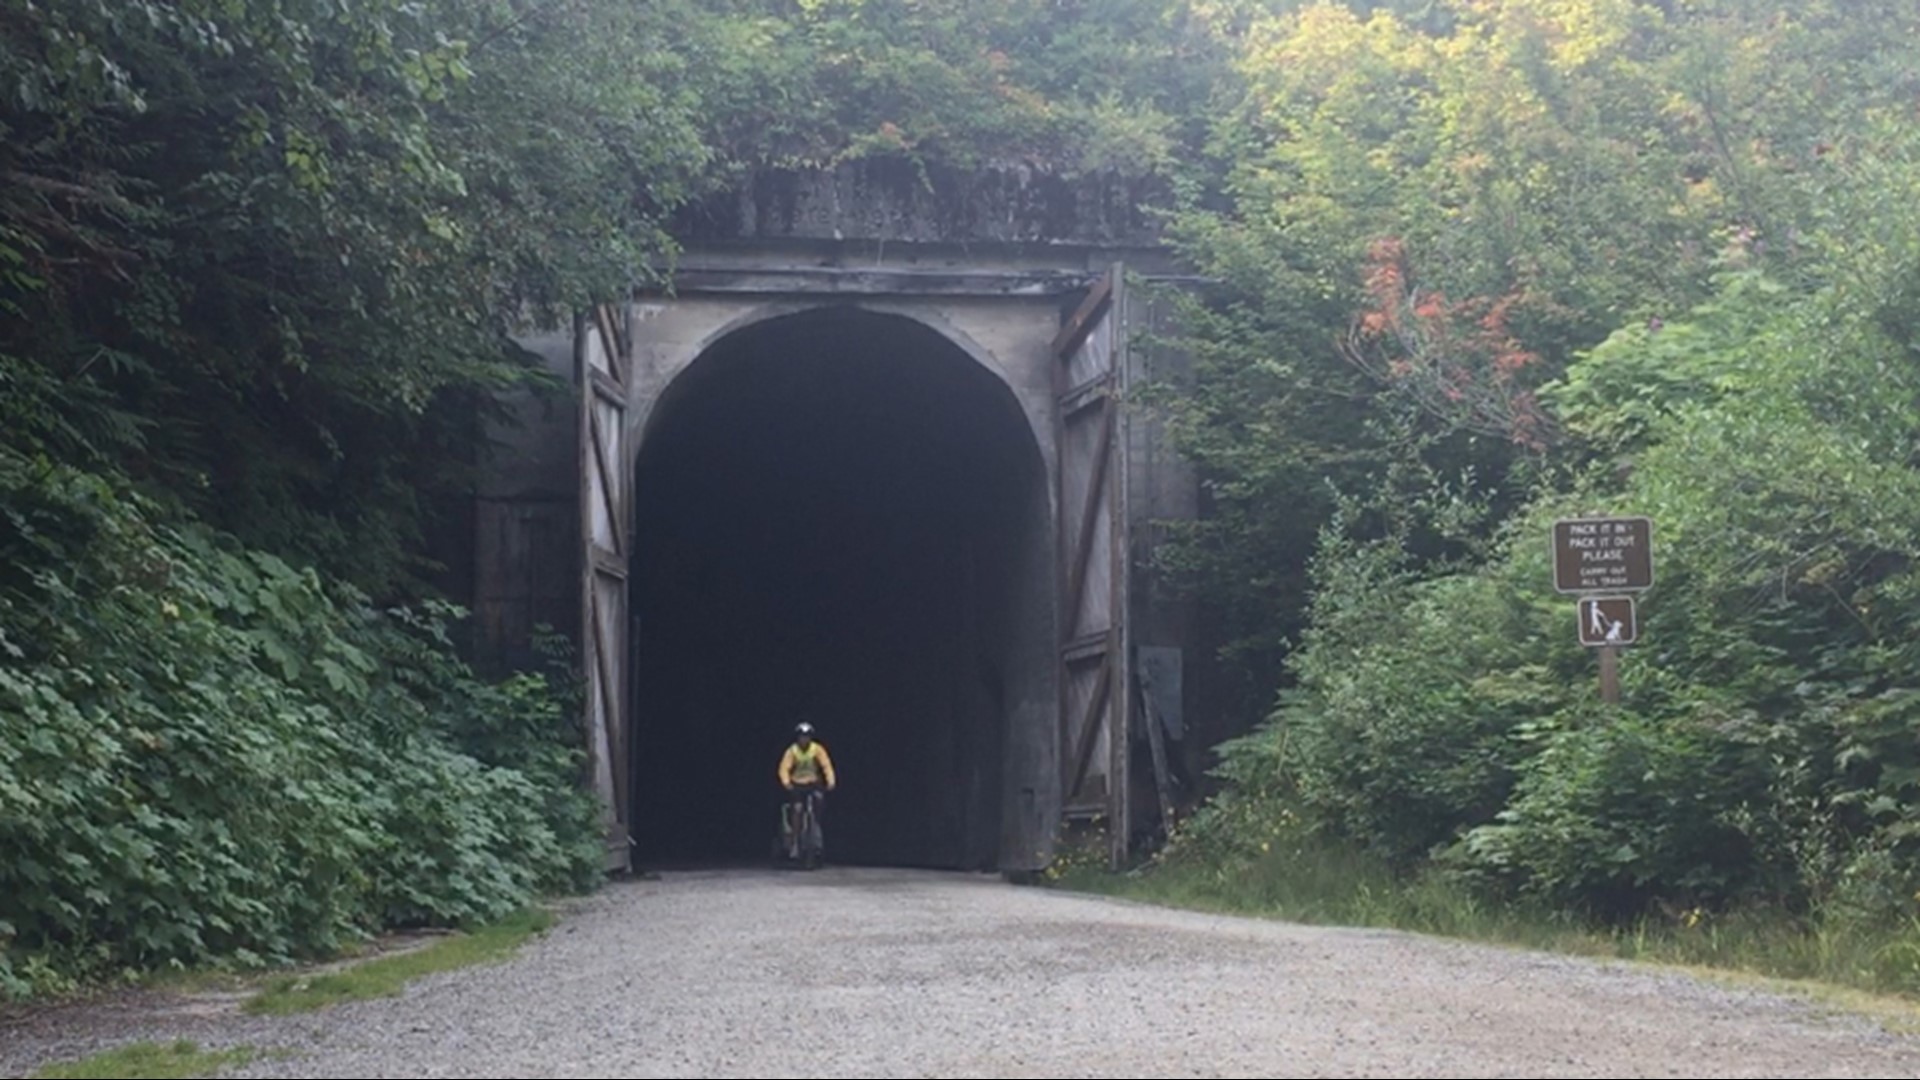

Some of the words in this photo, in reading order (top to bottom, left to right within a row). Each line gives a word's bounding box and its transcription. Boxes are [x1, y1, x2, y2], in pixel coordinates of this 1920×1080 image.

[1570, 525, 1596, 535] PACK
[1601, 524, 1611, 534] IT
[1569, 538, 1596, 548] PACK
[1600, 537, 1609, 547] IT
[1613, 536, 1634, 547] OUT
[1582, 550, 1623, 561] PLEASE
